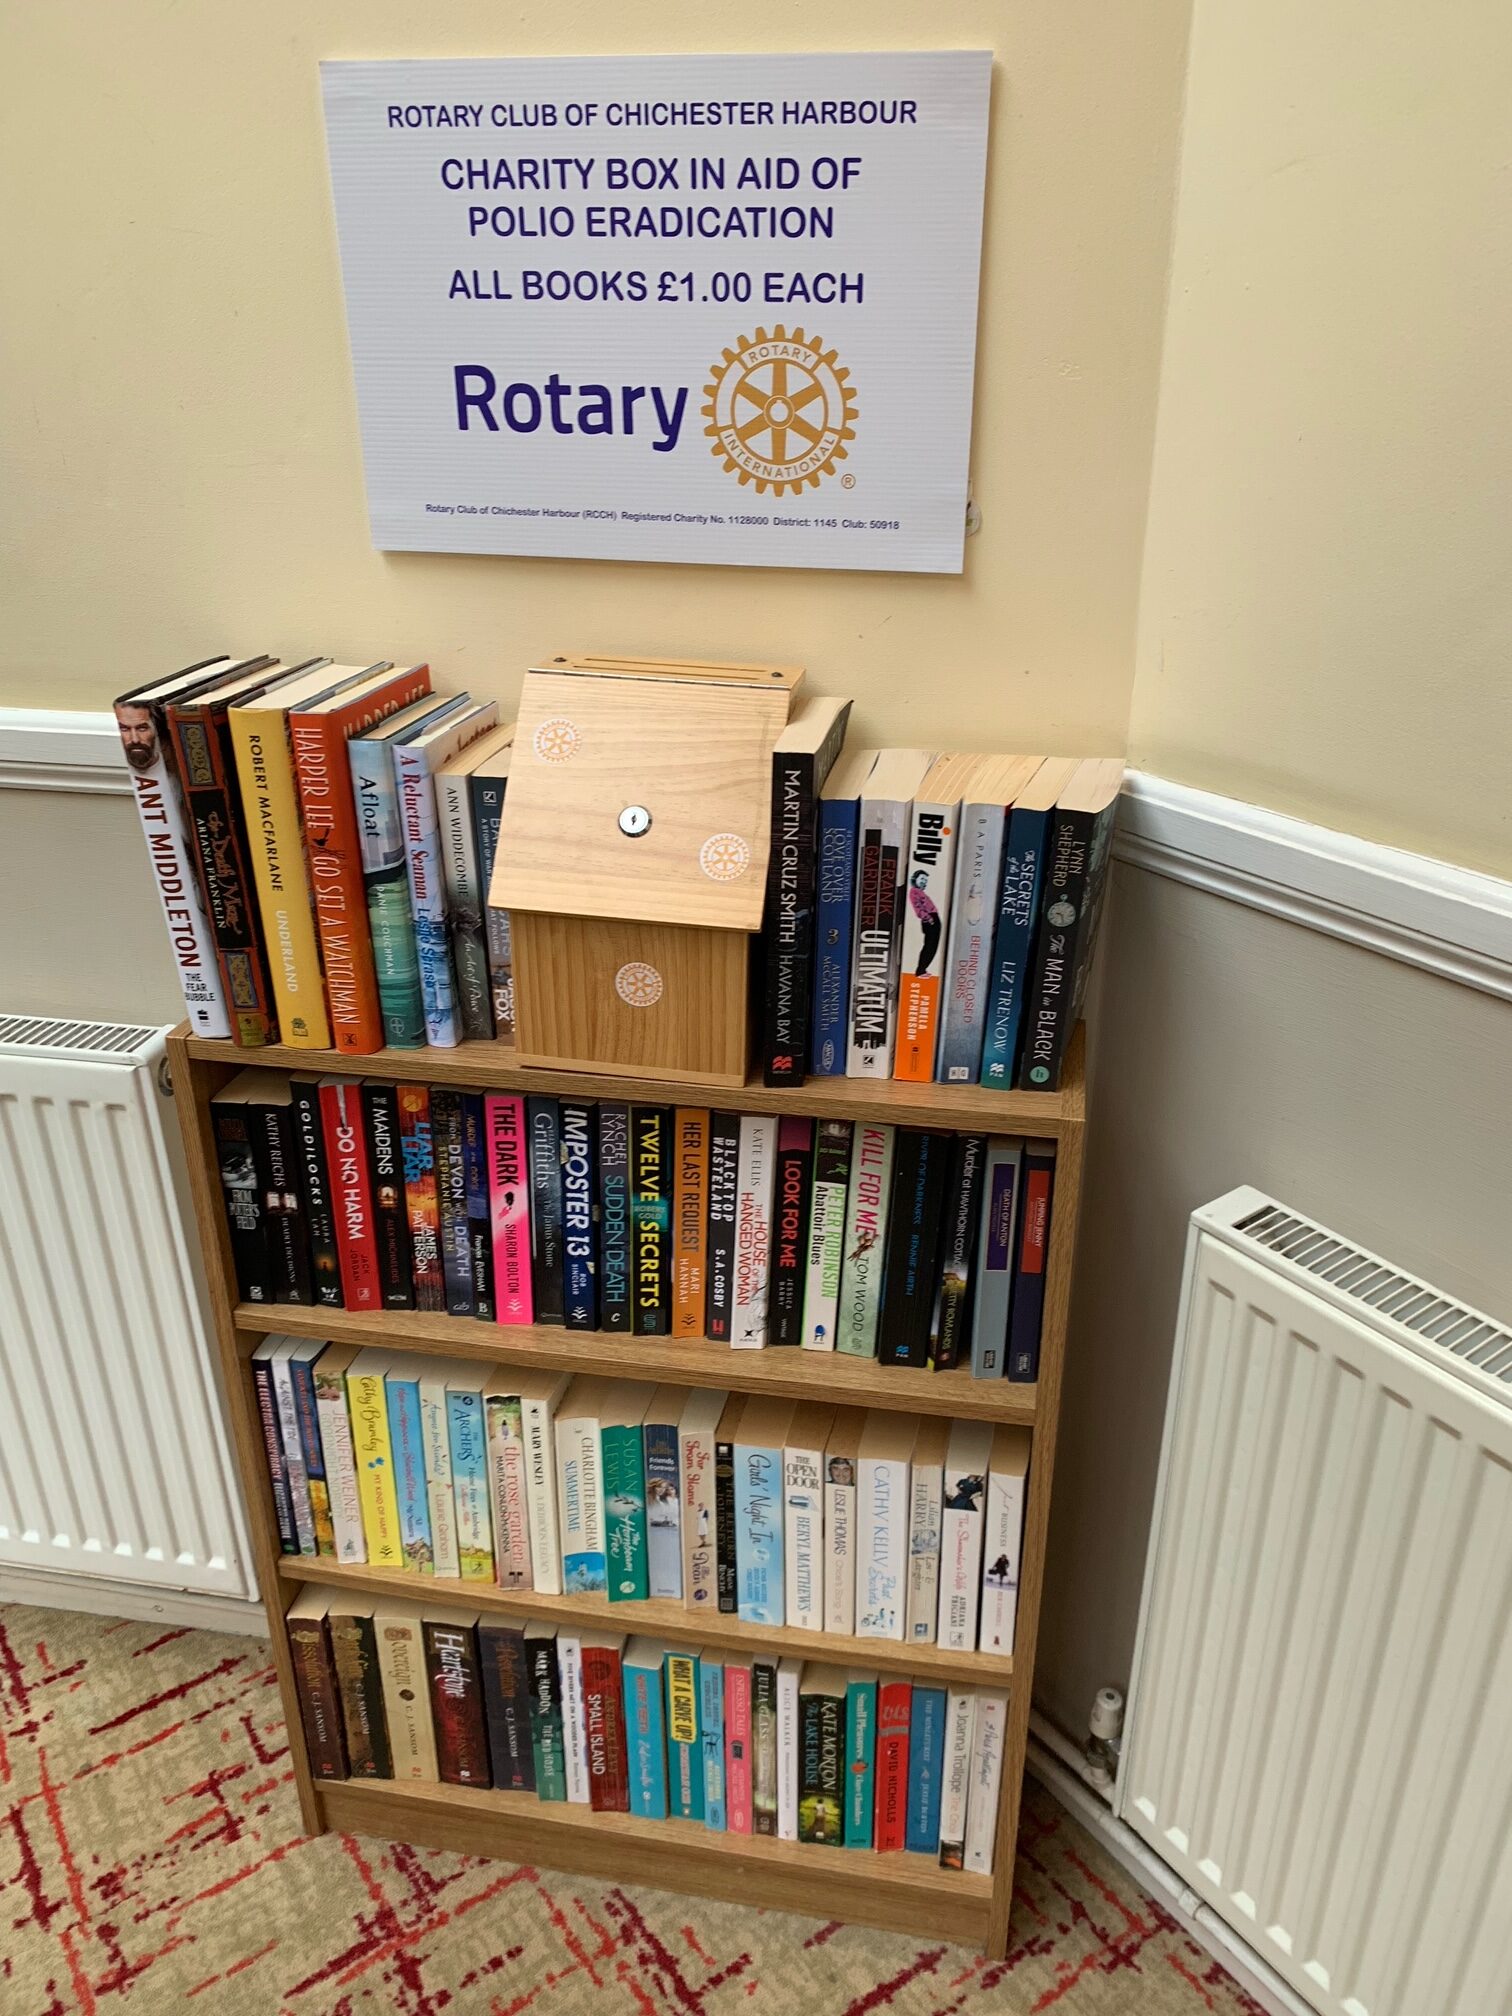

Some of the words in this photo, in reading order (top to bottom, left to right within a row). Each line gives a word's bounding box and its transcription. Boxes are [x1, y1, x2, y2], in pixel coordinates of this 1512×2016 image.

[388, 105, 483, 128] ROTARY
[491, 104, 558, 127] CLUB
[565, 104, 598, 126] OF
[606, 103, 773, 126] CHICHESTER
[782, 101, 917, 125] HARBOUR
[441, 158, 595, 190] CHARITY
[606, 158, 679, 190] BOX
[691, 158, 724, 190] IN
[737, 158, 799, 190] AID
[812, 158, 862, 190] OF
[470, 206, 574, 238] POLIO
[587, 206, 834, 239] ERADICATION
[449, 269, 512, 300] ALL
[523, 270, 647, 301] BOOKS
[658, 271, 751, 302] £1.00
[764, 272, 864, 304] EACH
[748, 344, 811, 363] ROTARY
[453, 365, 688, 452] Rotary
[724, 432, 835, 478] INTERNATIONAL
[426, 503, 454, 515] Rotary
[457, 505, 478, 514] Club
[480, 505, 489, 514] of
[491, 506, 540, 517] Chichester
[543, 508, 580, 518] Harbour
[582, 510, 617, 521] (RCCH)
[621, 511, 671, 523] Registered
[674, 513, 708, 525] Charity
[710, 515, 726, 524] No.
[728, 516, 769, 525] 1128000
[773, 517, 811, 527] District:
[814, 518, 838, 528] 1145
[842, 519, 867, 529] Club:
[870, 520, 900, 530] 50918
[294, 727, 327, 796] HARPER
[400, 756, 417, 766] A
[135, 775, 167, 825] ANT
[249, 735, 267, 790] ROBERT
[259, 797, 283, 892] MACFARLANE
[306, 800, 334, 830] LEE
[359, 776, 380, 838] Afloat
[402, 774, 423, 843] Reluctant
[446, 787, 459, 813] ANN
[783, 770, 800, 841] MARTIN
[451, 818, 468, 898] WIDDECOMBE
[914, 812, 951, 866] Billy
[1053, 824, 1074, 887] SHEPHERD
[1069, 841, 1085, 875] LYNN
[196, 818, 212, 863] ARIANA
[206, 868, 226, 929] FRANKLIN
[312, 854, 341, 879] GO
[411, 849, 429, 900] Seaman
[781, 845, 797, 889] CRUZ
[862, 845, 879, 927] GARDNER
[879, 858, 895, 915] FRANK
[148, 832, 201, 967] MIDDLETON
[316, 882, 345, 912] SET
[1001, 876, 1017, 916] LAKE
[1015, 864, 1035, 926] SECRETS
[320, 914, 345, 928] A
[780, 893, 796, 943] SMITH
[276, 910, 297, 992] UNDERLAND
[968, 935, 981, 976] BEHIND
[1049, 935, 1065, 953] The
[185, 972, 202, 982] THE
[185, 982, 208, 992] FEAR
[327, 932, 359, 1025] WATCHMAN
[778, 955, 793, 1015] HAVANA
[856, 929, 890, 1033] ULTIMATUM
[955, 960, 968, 999] DOORS
[1000, 961, 1016, 983] LIZ
[1042, 958, 1064, 993] MAN
[184, 991, 216, 1002] BUBBLE
[906, 983, 921, 1041] STEPHENSON
[919, 995, 930, 1030] PAMELA
[963, 979, 976, 1024] CLOSED
[1043, 997, 1053, 1006] in
[777, 1019, 790, 1044] BAY
[993, 989, 1012, 1054] TRENOW
[1033, 1010, 1056, 1060] BLACK
[336, 1125, 354, 1152] DO
[493, 1104, 517, 1136] THE
[682, 1122, 701, 1148] HER
[300, 1100, 323, 1205] GOLDILOCKS
[373, 1109, 393, 1174] MAIDENS
[400, 1136, 420, 1183] LIAR
[415, 1122, 433, 1169] LIAR
[639, 1115, 659, 1202] TWELVE
[860, 1128, 885, 1167] KILL
[340, 1158, 358, 1184] NO
[495, 1141, 519, 1186] DARK
[564, 1110, 590, 1229] IMPOSTER
[682, 1152, 700, 1189] LAST
[710, 1137, 724, 1221] WASTELAND
[722, 1138, 736, 1222] BLACKTOP
[782, 1161, 801, 1206] LOOK
[813, 1185, 827, 1231] Abattoir
[825, 1186, 843, 1226] PETER
[857, 1172, 881, 1205] FOR
[343, 1189, 365, 1239] HARM
[605, 1175, 624, 1244] SUDDEN
[681, 1192, 700, 1252] REQUEST
[739, 1192, 754, 1249] HANGED
[781, 1209, 799, 1240] FOR
[855, 1210, 877, 1235] ME
[412, 1210, 427, 1274] PATTERSON
[423, 1223, 437, 1259] JAMES
[505, 1224, 519, 1258] SHARON
[567, 1235, 590, 1256] 13
[752, 1221, 768, 1267] HOUSE
[780, 1244, 796, 1267] ME
[811, 1234, 825, 1266] Blues
[507, 1261, 520, 1293] BOLTON
[605, 1250, 625, 1302] DEATH
[639, 1221, 659, 1307] SECRETS
[737, 1252, 751, 1306] WOMAN
[820, 1231, 840, 1298] ROBINSON
[855, 1257, 870, 1285] TOM
[852, 1289, 865, 1332] WOOD
[582, 1437, 596, 1500] CHARLOTTE
[605, 1444, 619, 1489] LEWIS
[622, 1439, 638, 1492] SUSAN
[747, 1454, 771, 1491] Girls'
[786, 1464, 817, 1477] OPEN
[787, 1476, 819, 1490] DOOR
[564, 1460, 580, 1533] SUMMERTIME
[744, 1494, 771, 1526] Night
[583, 1502, 598, 1551] BINGHAM
[748, 1528, 774, 1544] In
[796, 1516, 810, 1549] BERYL
[796, 1551, 811, 1611] MATTHEWS
[672, 1660, 691, 1685] WHAT
[587, 1694, 603, 1731] SMALL
[673, 1695, 690, 1722] CARVE
[822, 1701, 837, 1733] KATE
[674, 1725, 694, 1741] UP!
[805, 1720, 818, 1746] LAKE
[954, 1713, 968, 1751] Joanna
[591, 1734, 606, 1775] ISLAND
[806, 1749, 818, 1785] HOUSE
[818, 1735, 836, 1790] MORTON
[888, 1742, 898, 1772] DAVID
[951, 1754, 967, 1793] Trollope
[886, 1776, 897, 1823] NICHOLLS
